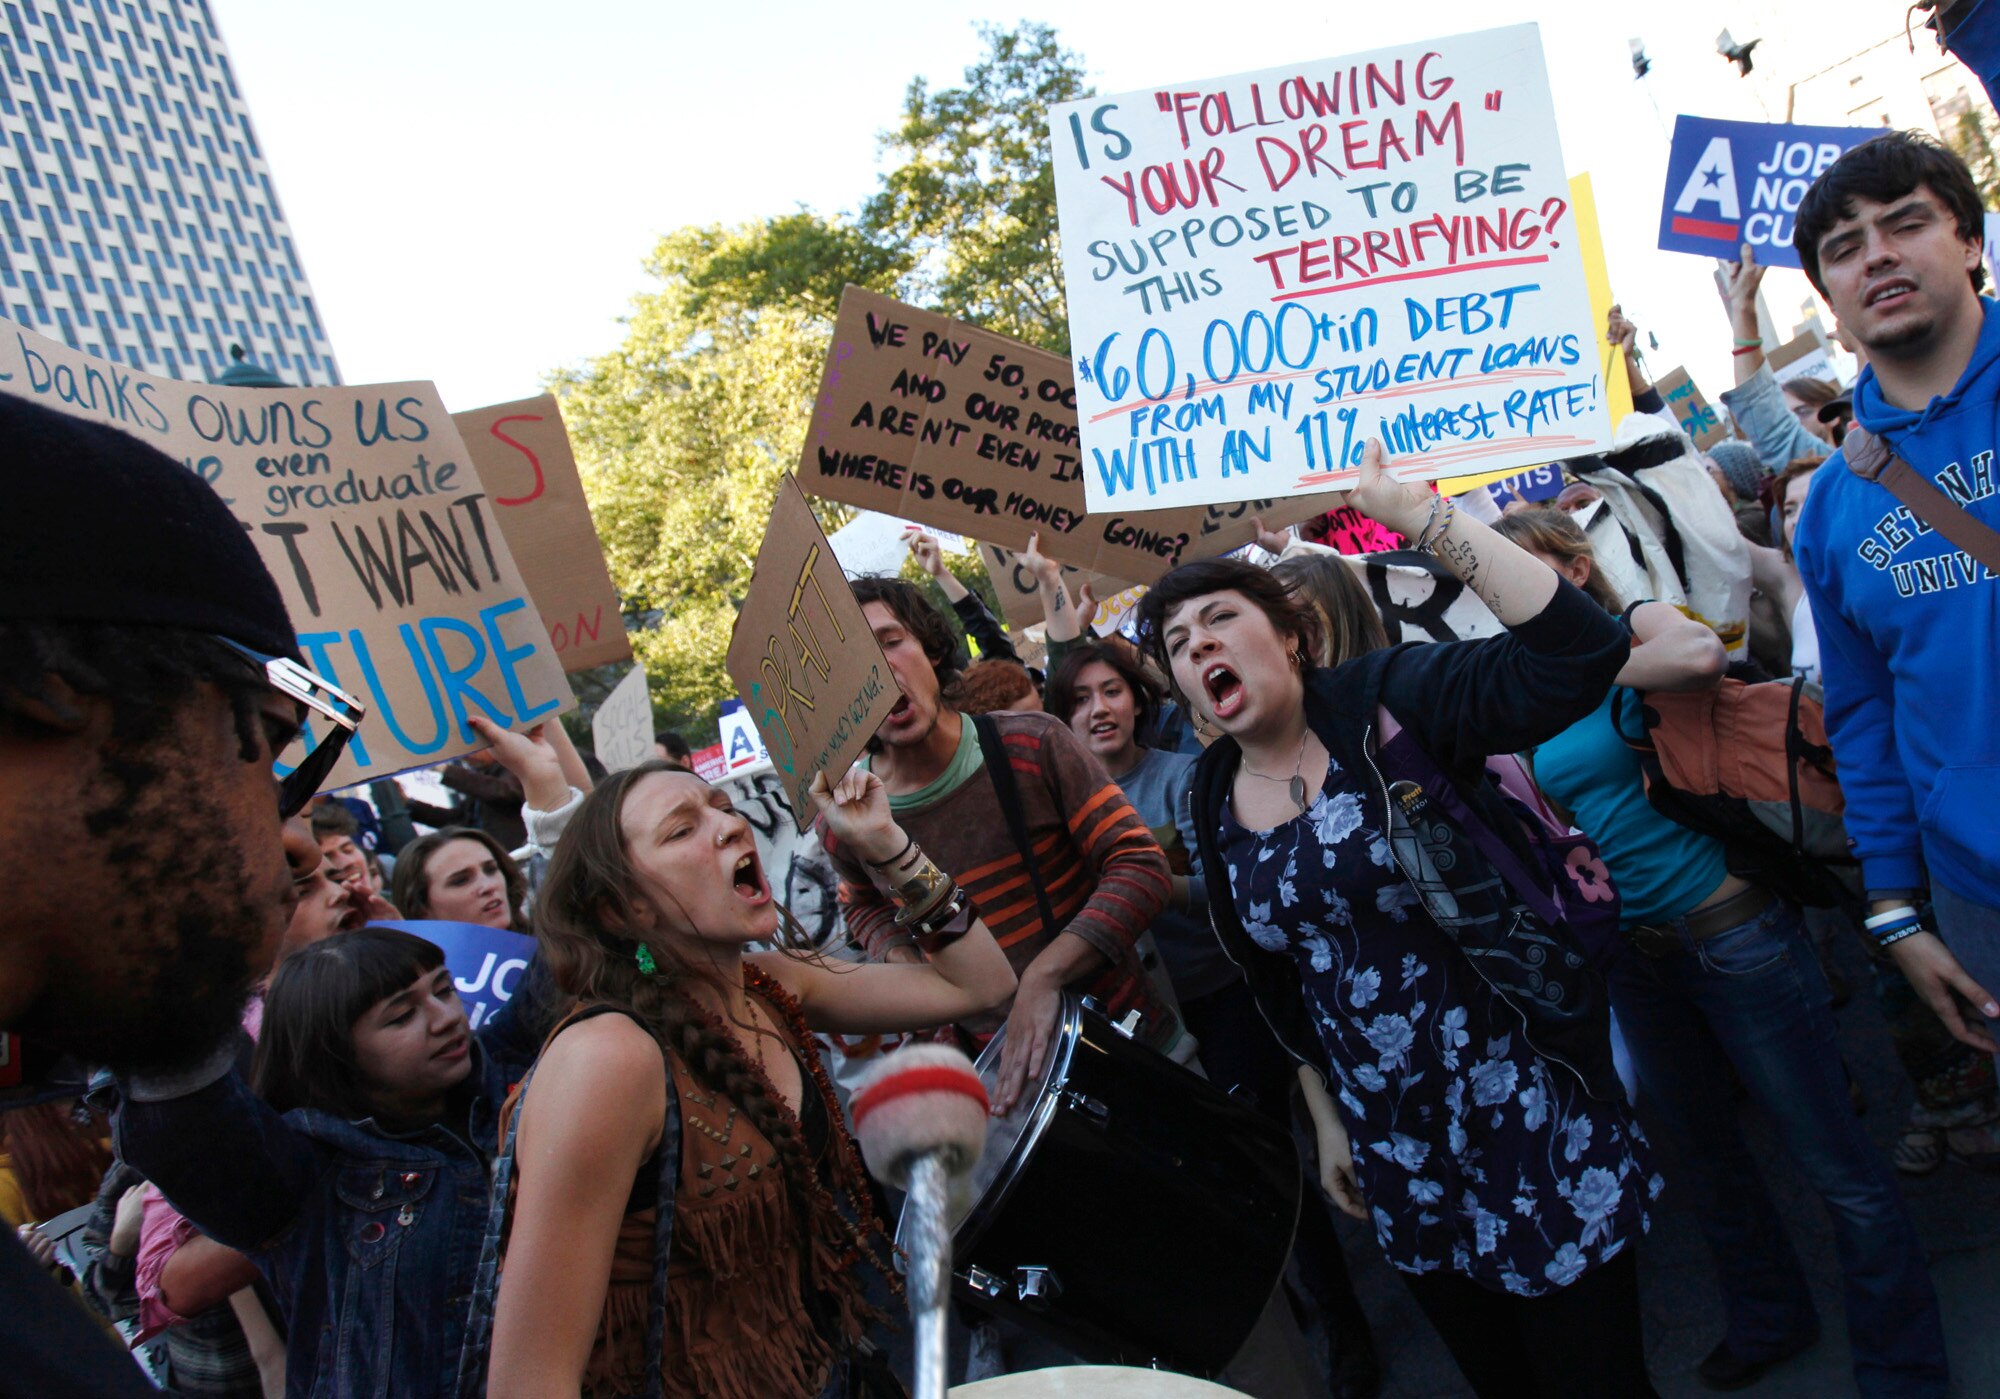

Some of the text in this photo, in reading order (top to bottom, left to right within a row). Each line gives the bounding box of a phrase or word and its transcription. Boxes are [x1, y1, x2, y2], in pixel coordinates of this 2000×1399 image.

[1069, 52, 1455, 169] IS "FOLLOWING
[1757, 140, 1860, 177] JOB
[1086, 163, 1532, 281] SUPPOSED TO BE
[1101, 146, 1247, 227] YOUR
[1744, 213, 1795, 247] CU
[1751, 176, 1815, 213] NO
[1123, 197, 1568, 315] THIS TERRIFYING?
[866, 311, 1077, 411] WE PAY 50,00
[1404, 283, 1541, 342] DEBT
[17, 331, 170, 434] banks
[890, 368, 1081, 450] AND OUR PROF
[1130, 334, 1581, 438] FROM MY STUDENT LOANS
[255, 452, 331, 478] even
[264, 453, 462, 517] graduate
[851, 402, 970, 447] AREN'T
[977, 432, 1040, 472] EVEN
[1092, 437, 1197, 497] WITH
[1220, 427, 1272, 479] AN
[1295, 407, 1366, 472] 11%
[1503, 374, 1599, 438] RATE!
[331, 492, 500, 610] WANT
[818, 446, 902, 490] WHERE
[908, 471, 934, 494] IS
[942, 478, 999, 515] OUR
[1004, 491, 1084, 534] MONEY
[1103, 517, 1190, 566] GOING?
[1890, 549, 2000, 598] UNIV
[272, 597, 559, 778] TURE
[760, 542, 846, 749] PRATT
